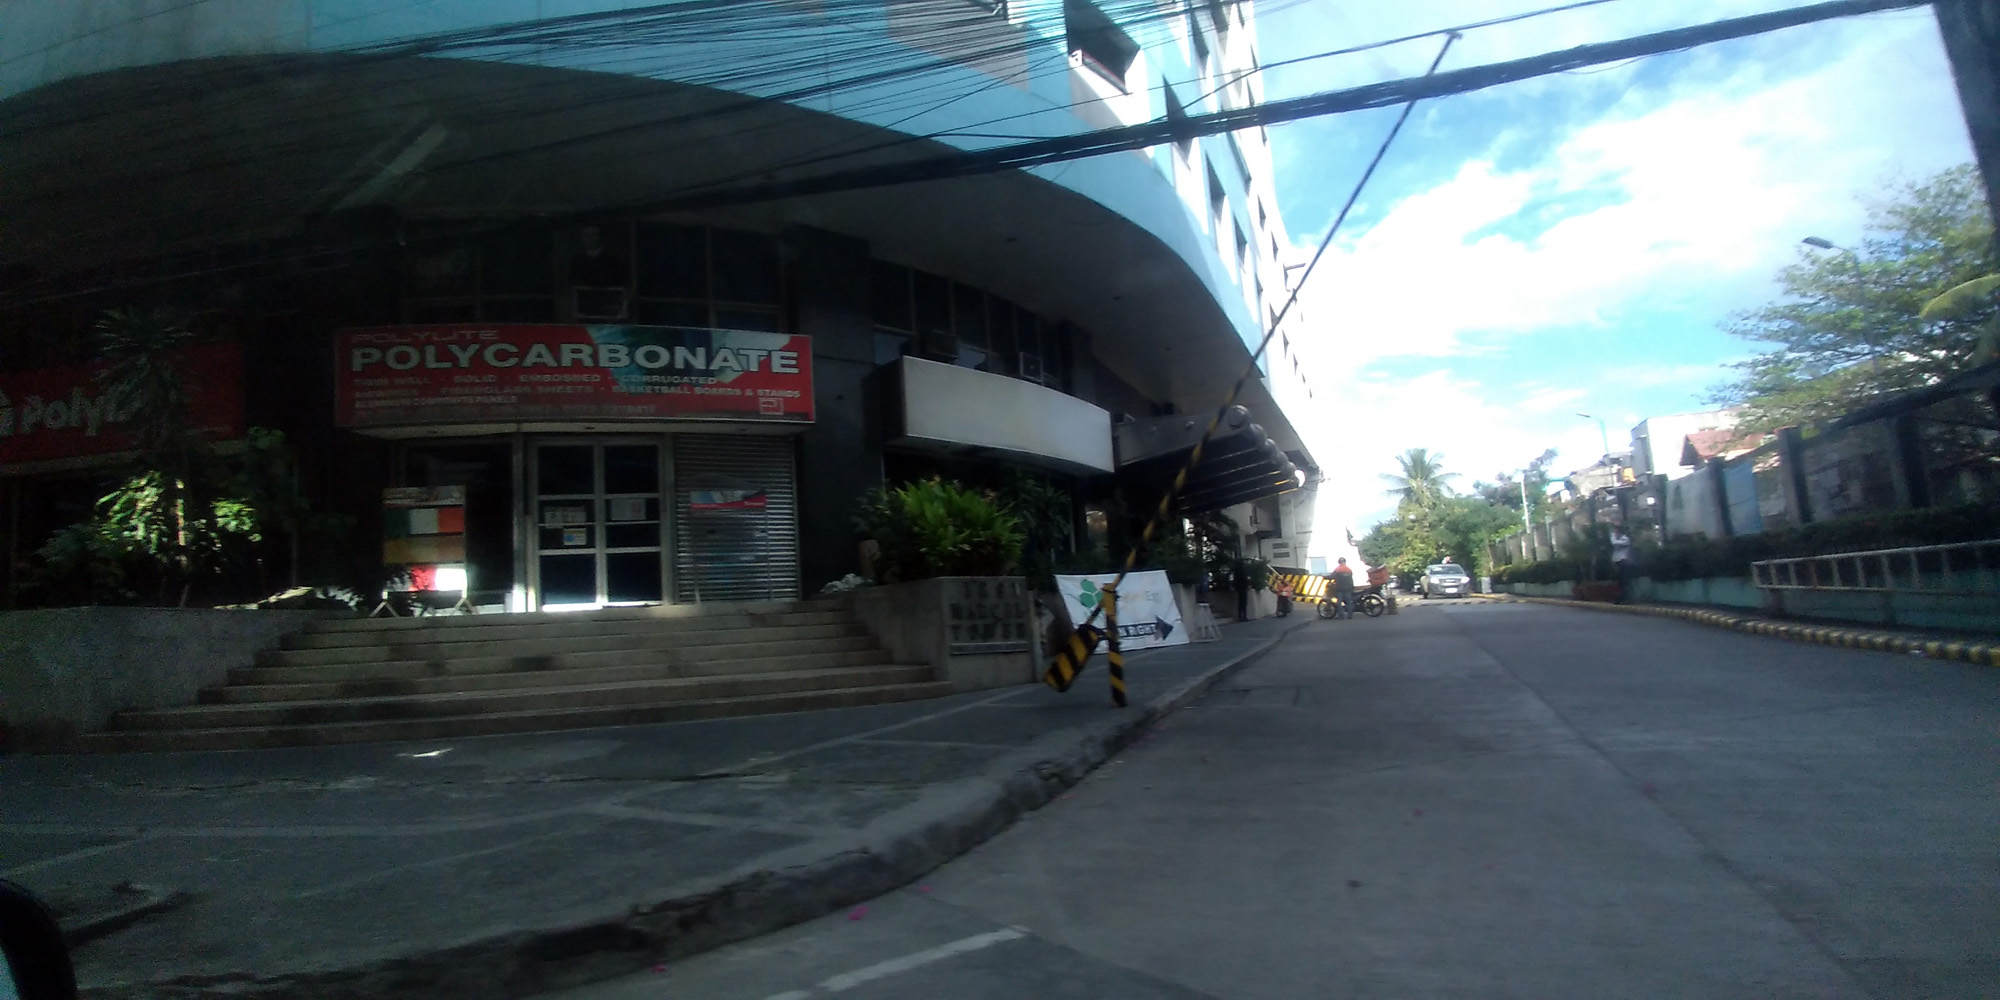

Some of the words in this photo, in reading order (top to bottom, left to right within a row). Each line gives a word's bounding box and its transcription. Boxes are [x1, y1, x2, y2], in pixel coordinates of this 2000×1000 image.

[351, 342, 801, 374] POLYCARBONATE
[453, 374, 497, 384] SOLID
[518, 373, 602, 383] EMBOSSED
[622, 374, 717, 384] CORRUGATED
[755, 388, 802, 398] STANDS
